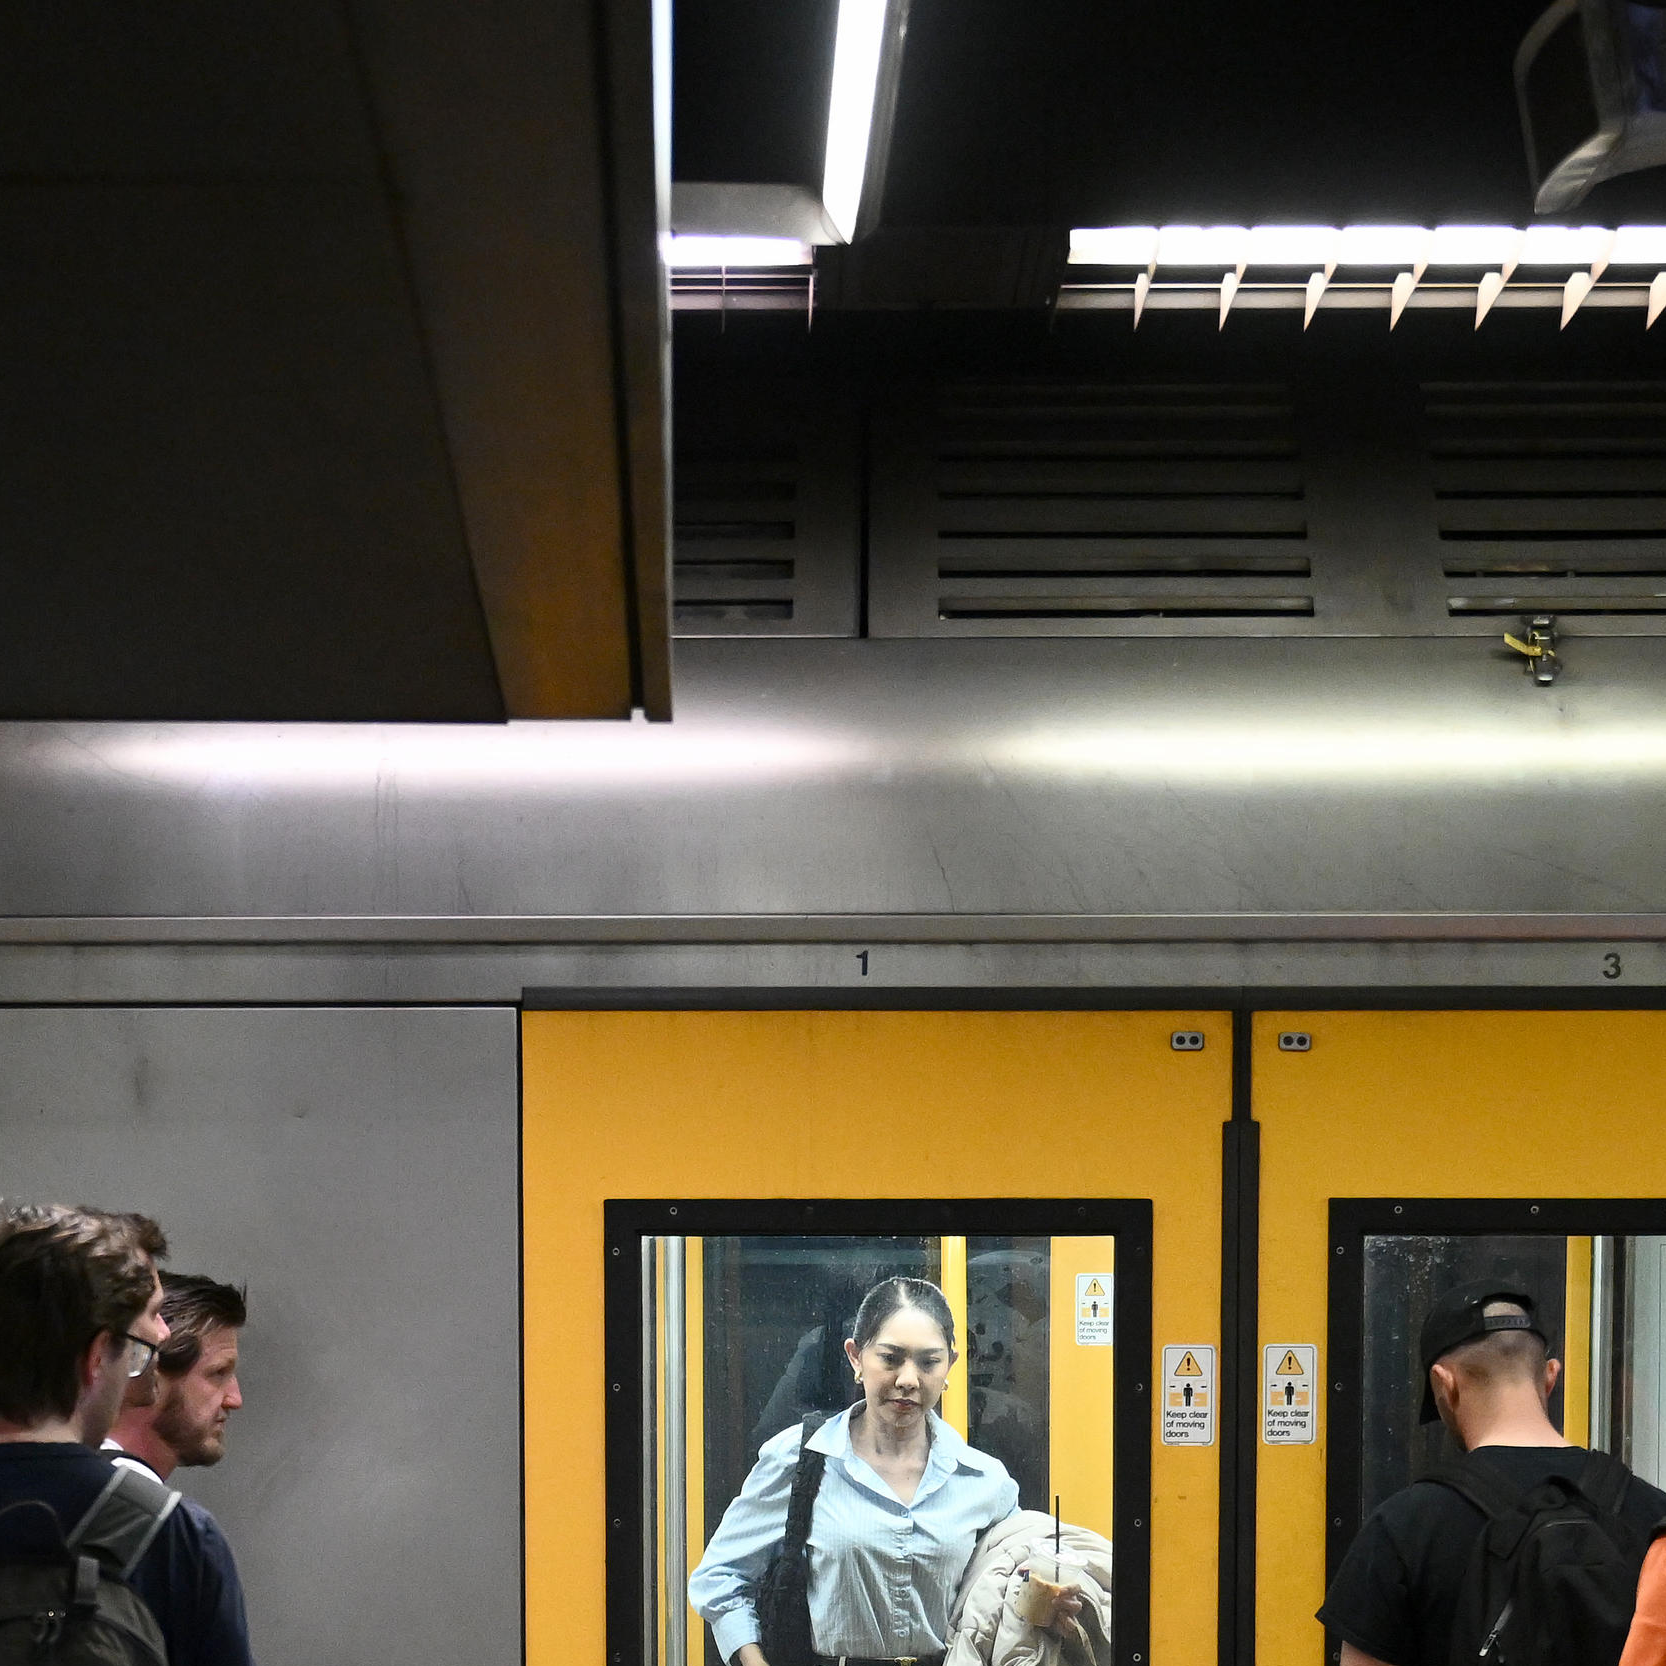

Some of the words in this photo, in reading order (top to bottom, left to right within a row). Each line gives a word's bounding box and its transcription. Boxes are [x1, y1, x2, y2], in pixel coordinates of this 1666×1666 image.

[856, 950, 868, 976] 1
[1603, 952, 1621, 979] 3
[1166, 1411, 1186, 1420] Keep
[1189, 1411, 1208, 1419] clear
[1267, 1410, 1288, 1418] Keep
[1290, 1410, 1309, 1418] clear
[1175, 1421, 1205, 1430] moving
[1277, 1420, 1306, 1428] moving
[1267, 1429, 1290, 1437] doors
